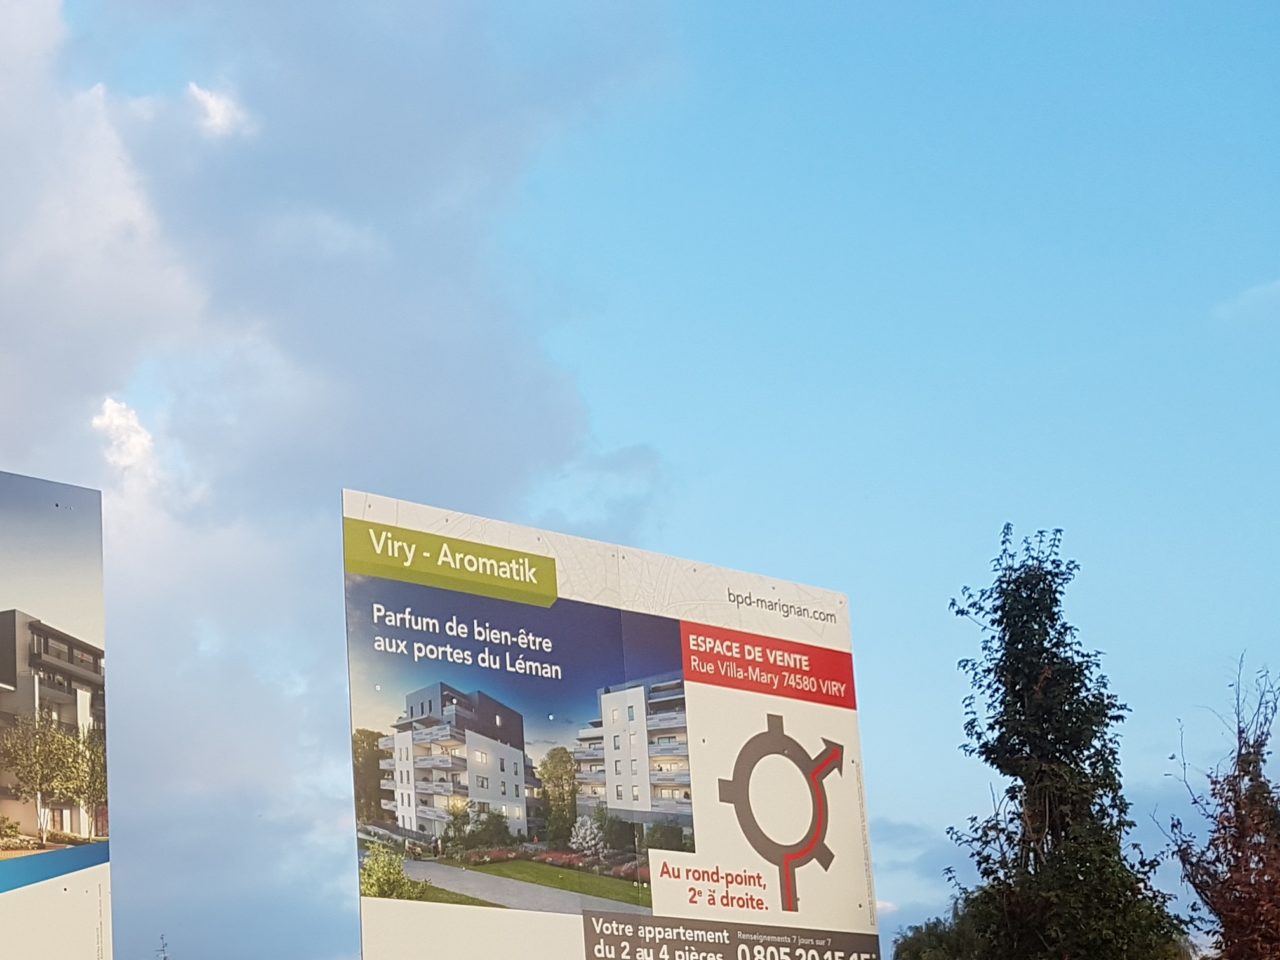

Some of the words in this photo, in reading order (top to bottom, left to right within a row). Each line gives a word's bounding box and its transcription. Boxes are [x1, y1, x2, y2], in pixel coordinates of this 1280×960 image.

[368, 528, 416, 567] Viry
[437, 543, 538, 585] Aromatik
[727, 587, 837, 625] bpd-marignan.com
[372, 603, 440, 634] Parfum
[445, 616, 468, 638] de
[473, 620, 552, 652] bien-être
[374, 636, 408, 655] aux
[413, 642, 473, 665] portes
[477, 647, 500, 670] du
[505, 652, 562, 680] Léman
[689, 634, 740, 659] ESPACE
[744, 646, 763, 662] DE
[766, 649, 810, 672] VENTE
[691, 656, 715, 675] Rue
[718, 661, 779, 689] Villa-Mary
[782, 672, 817, 692] 74580
[819, 679, 846, 698] VIRY
[660, 861, 682, 881] Au
[686, 865, 767, 890] rond-point,
[707, 891, 716, 906] à
[720, 889, 769, 911] droite.
[592, 917, 633, 937] Votre
[637, 924, 730, 944] appartement
[737, 931, 791, 943] Renseignements
[798, 936, 814, 946] jours
[594, 941, 616, 959] du
[620, 942, 631, 960] 2
